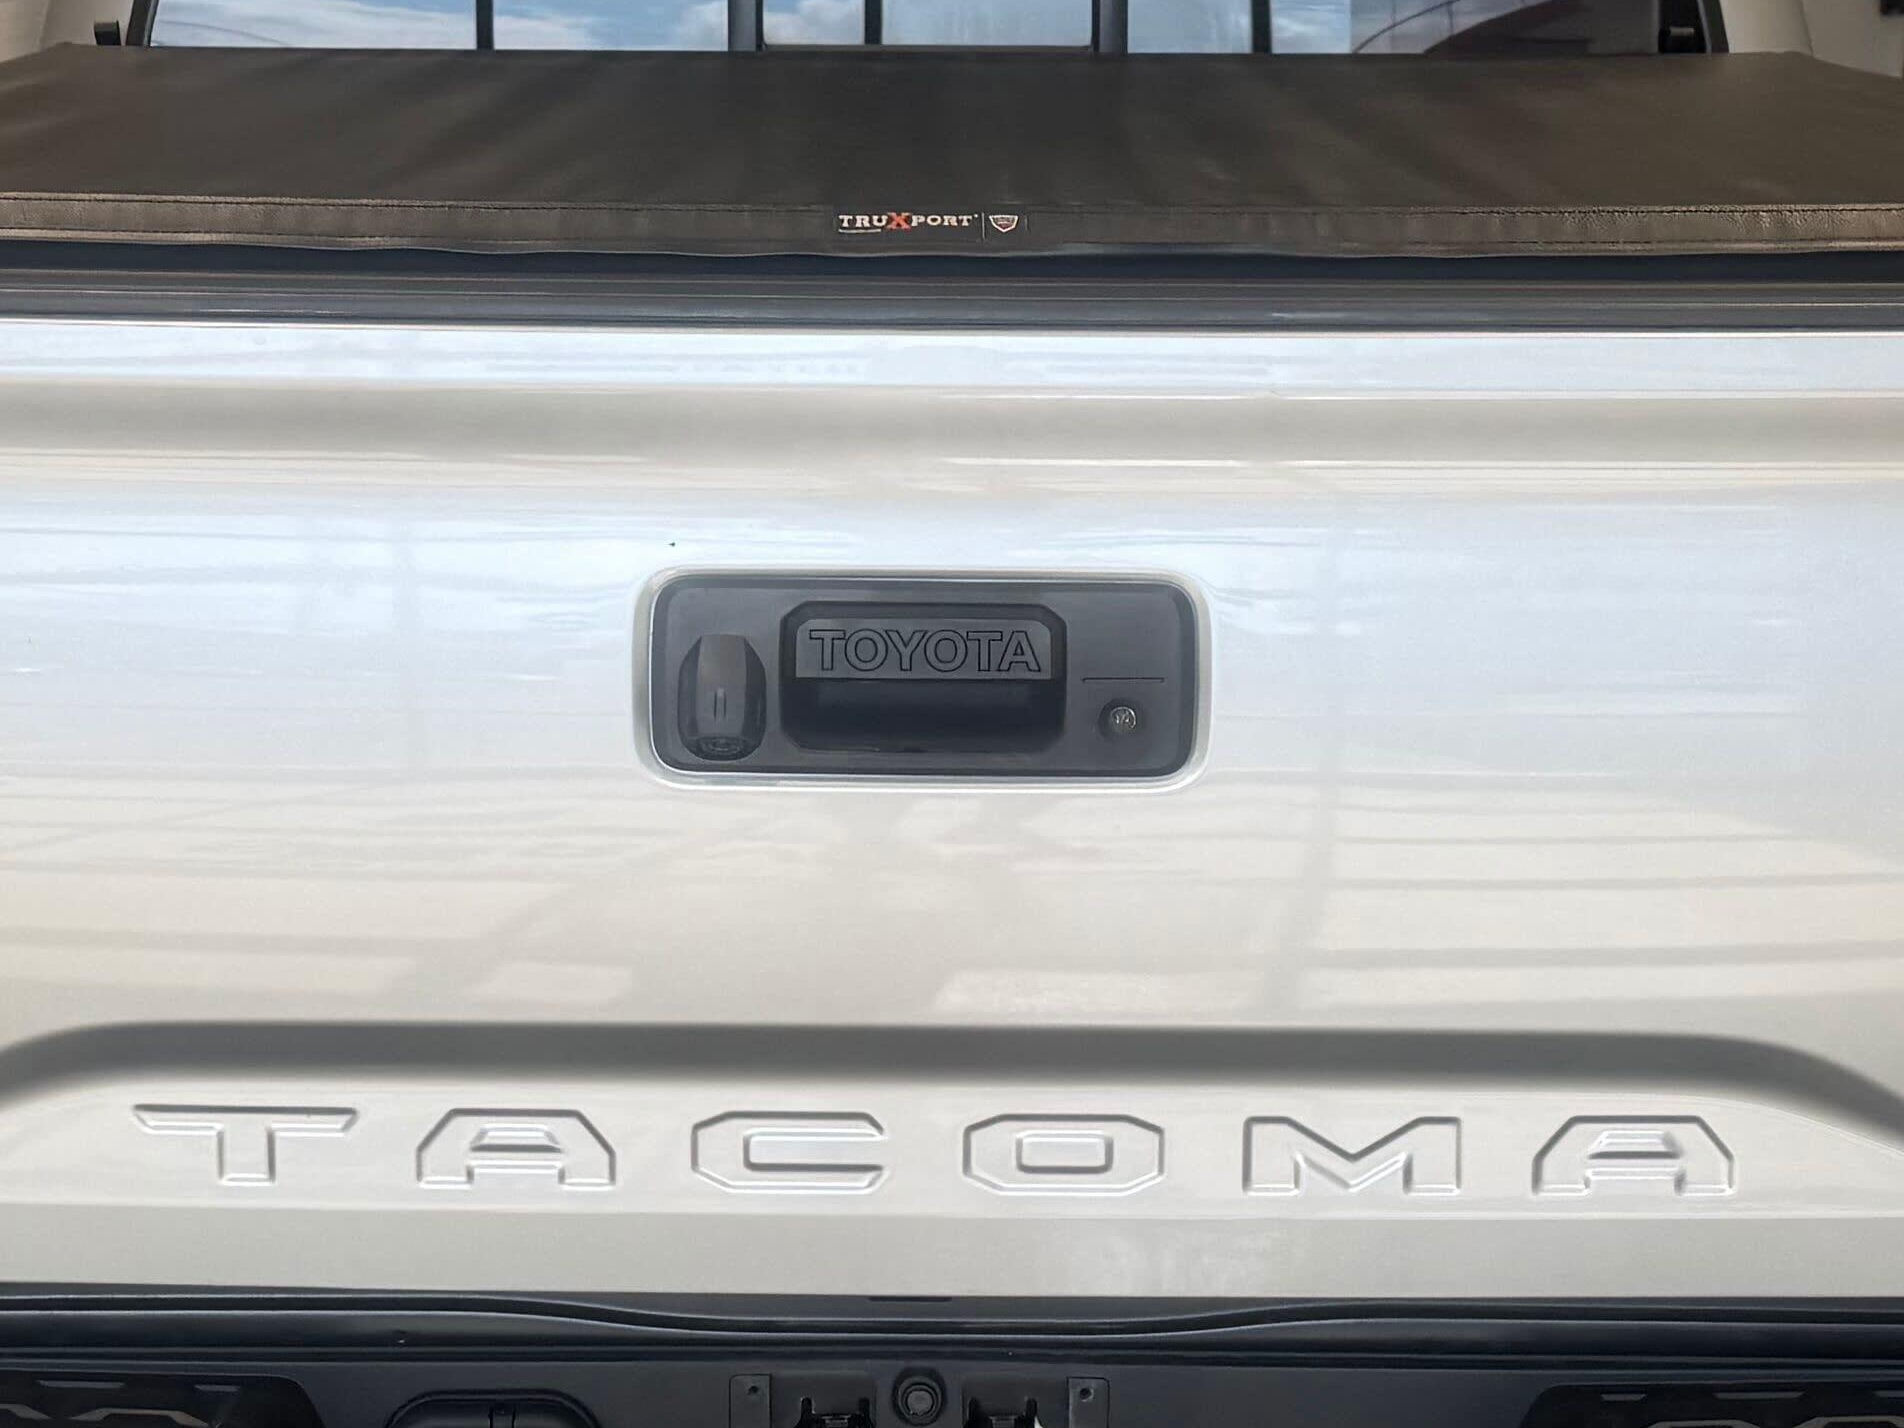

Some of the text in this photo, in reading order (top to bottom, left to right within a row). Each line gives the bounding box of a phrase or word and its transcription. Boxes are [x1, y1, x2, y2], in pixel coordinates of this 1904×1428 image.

[838, 212, 972, 230] TRUXPORT
[809, 629, 1041, 673] TOYOTA
[132, 1103, 1736, 1196] TACOMA
